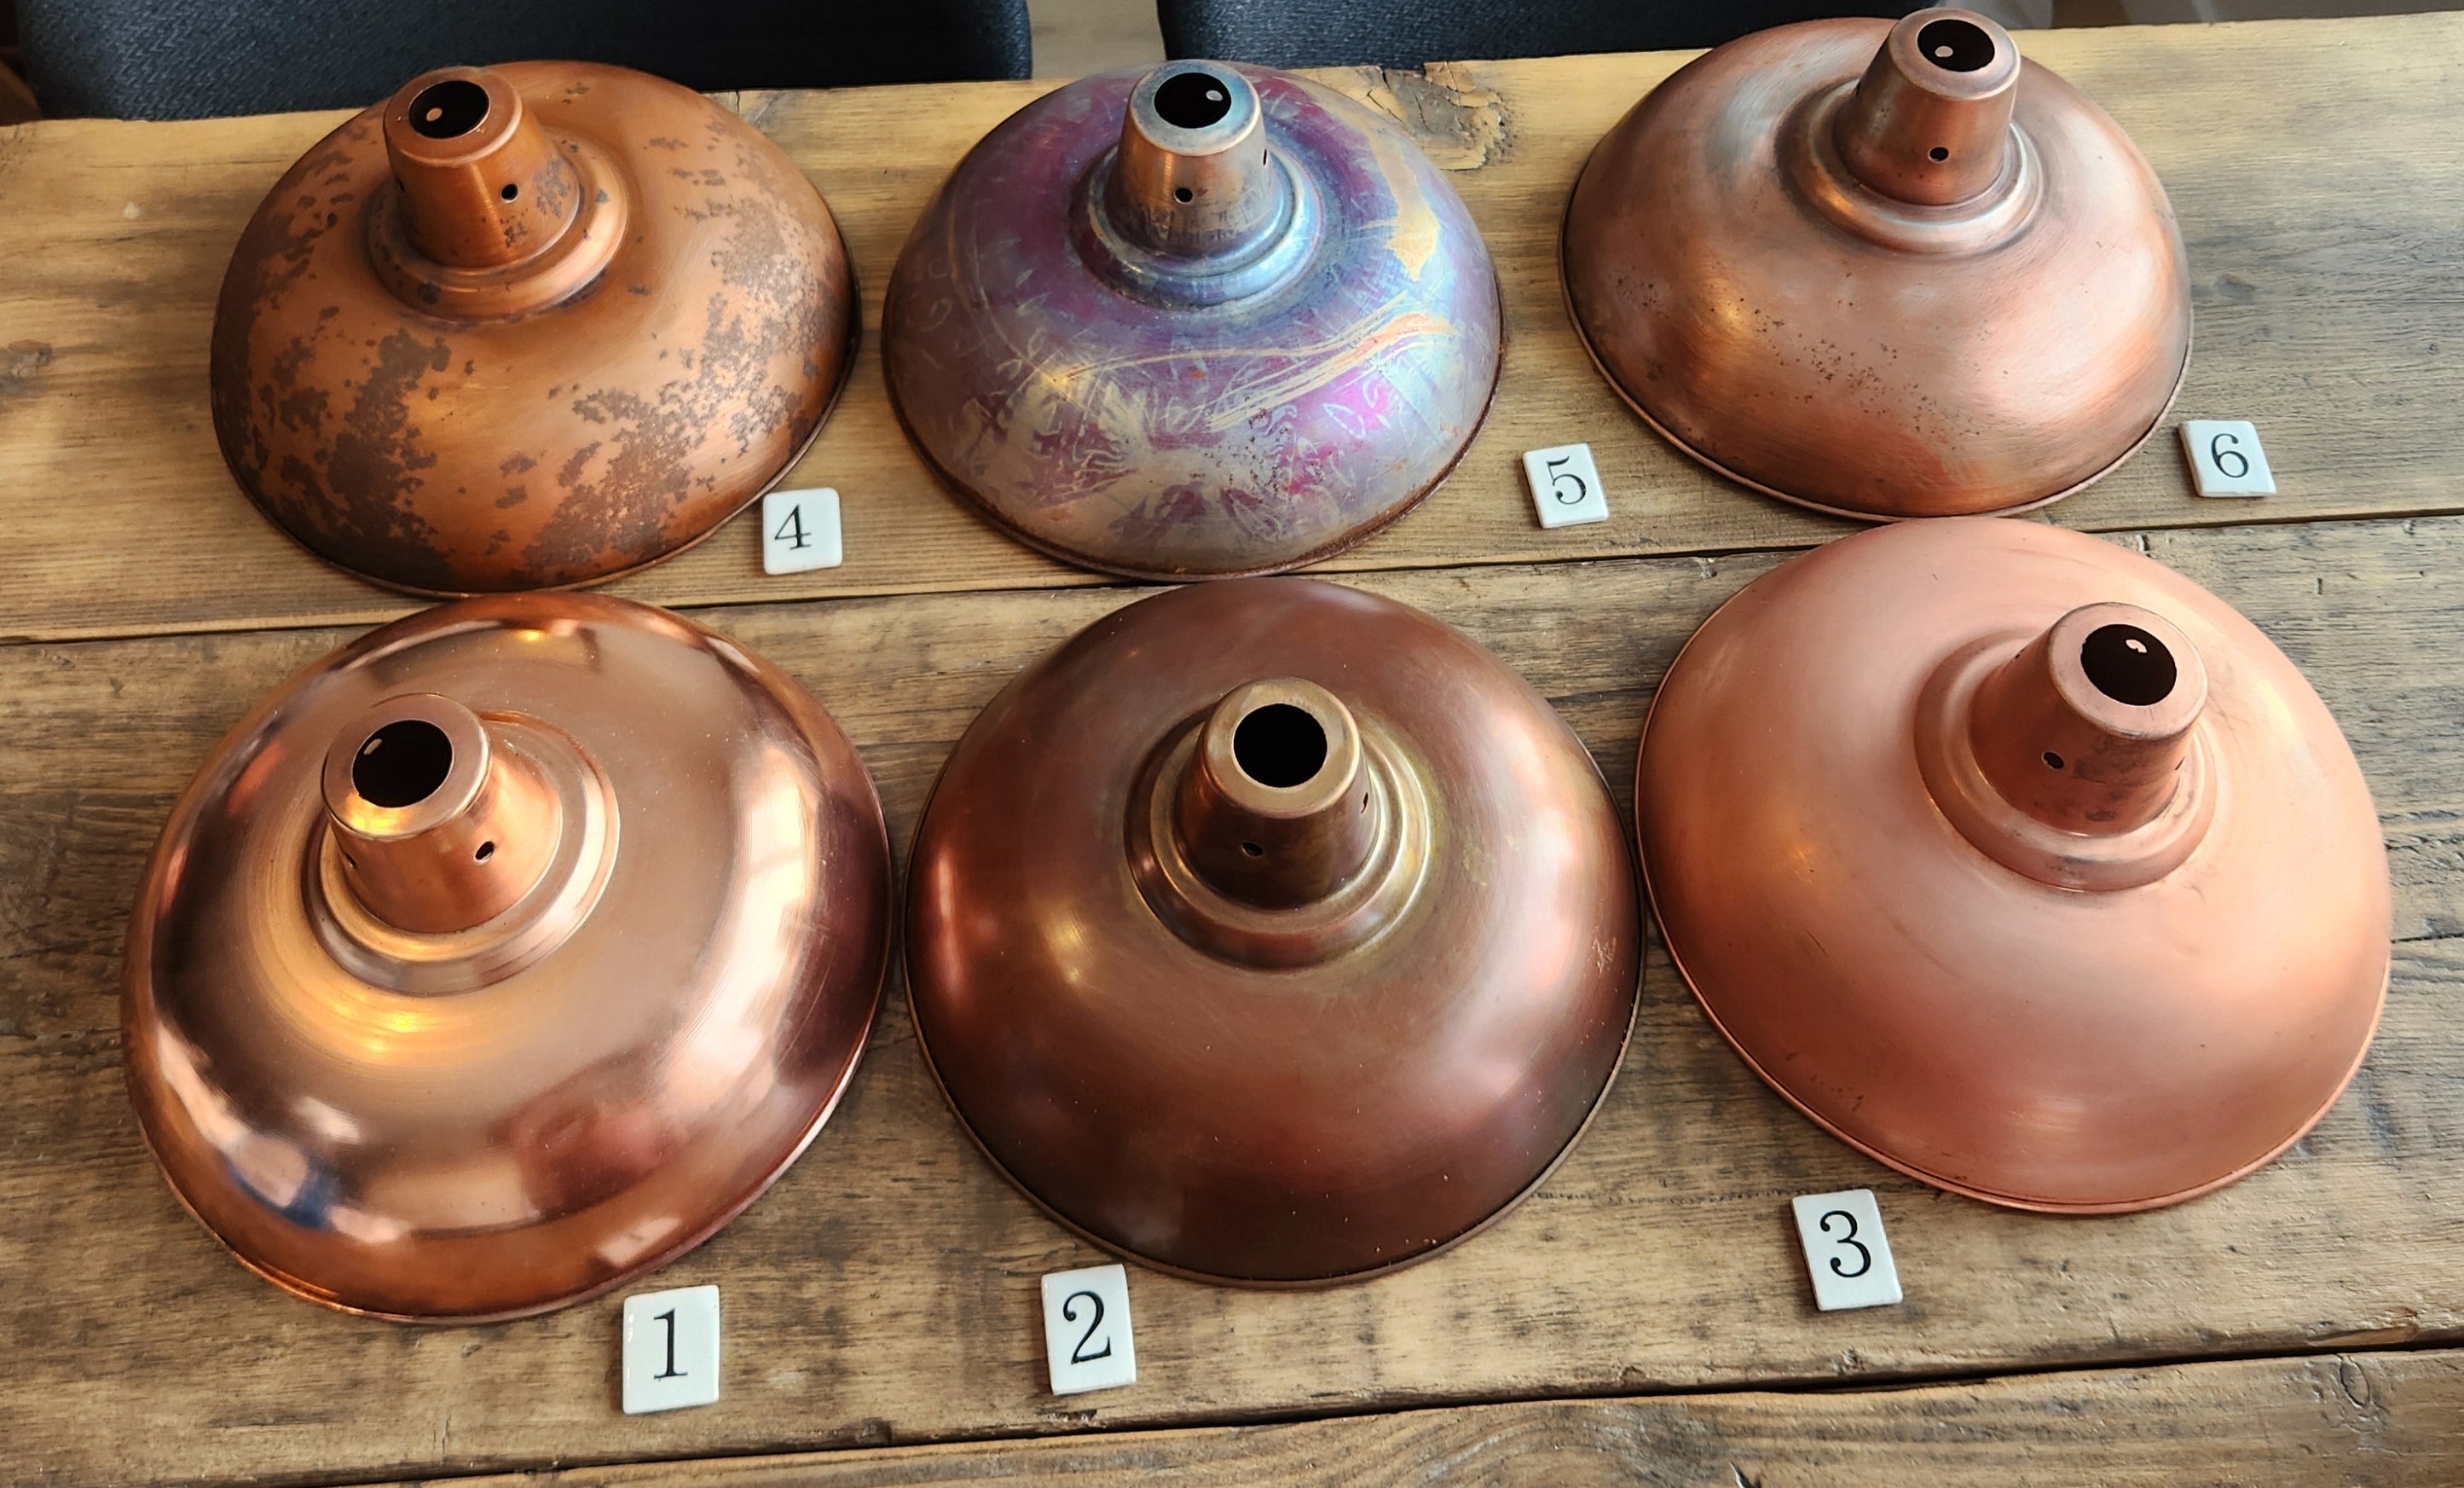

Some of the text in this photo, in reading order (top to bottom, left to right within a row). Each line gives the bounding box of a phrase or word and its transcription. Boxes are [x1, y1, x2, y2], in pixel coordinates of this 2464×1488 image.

[1544, 455, 1588, 506] 5
[2210, 433, 2249, 478] 6
[773, 504, 812, 550] 4
[1819, 1210, 1871, 1278] 3
[653, 1309, 687, 1379] 1
[1062, 1290, 1112, 1364] 2
